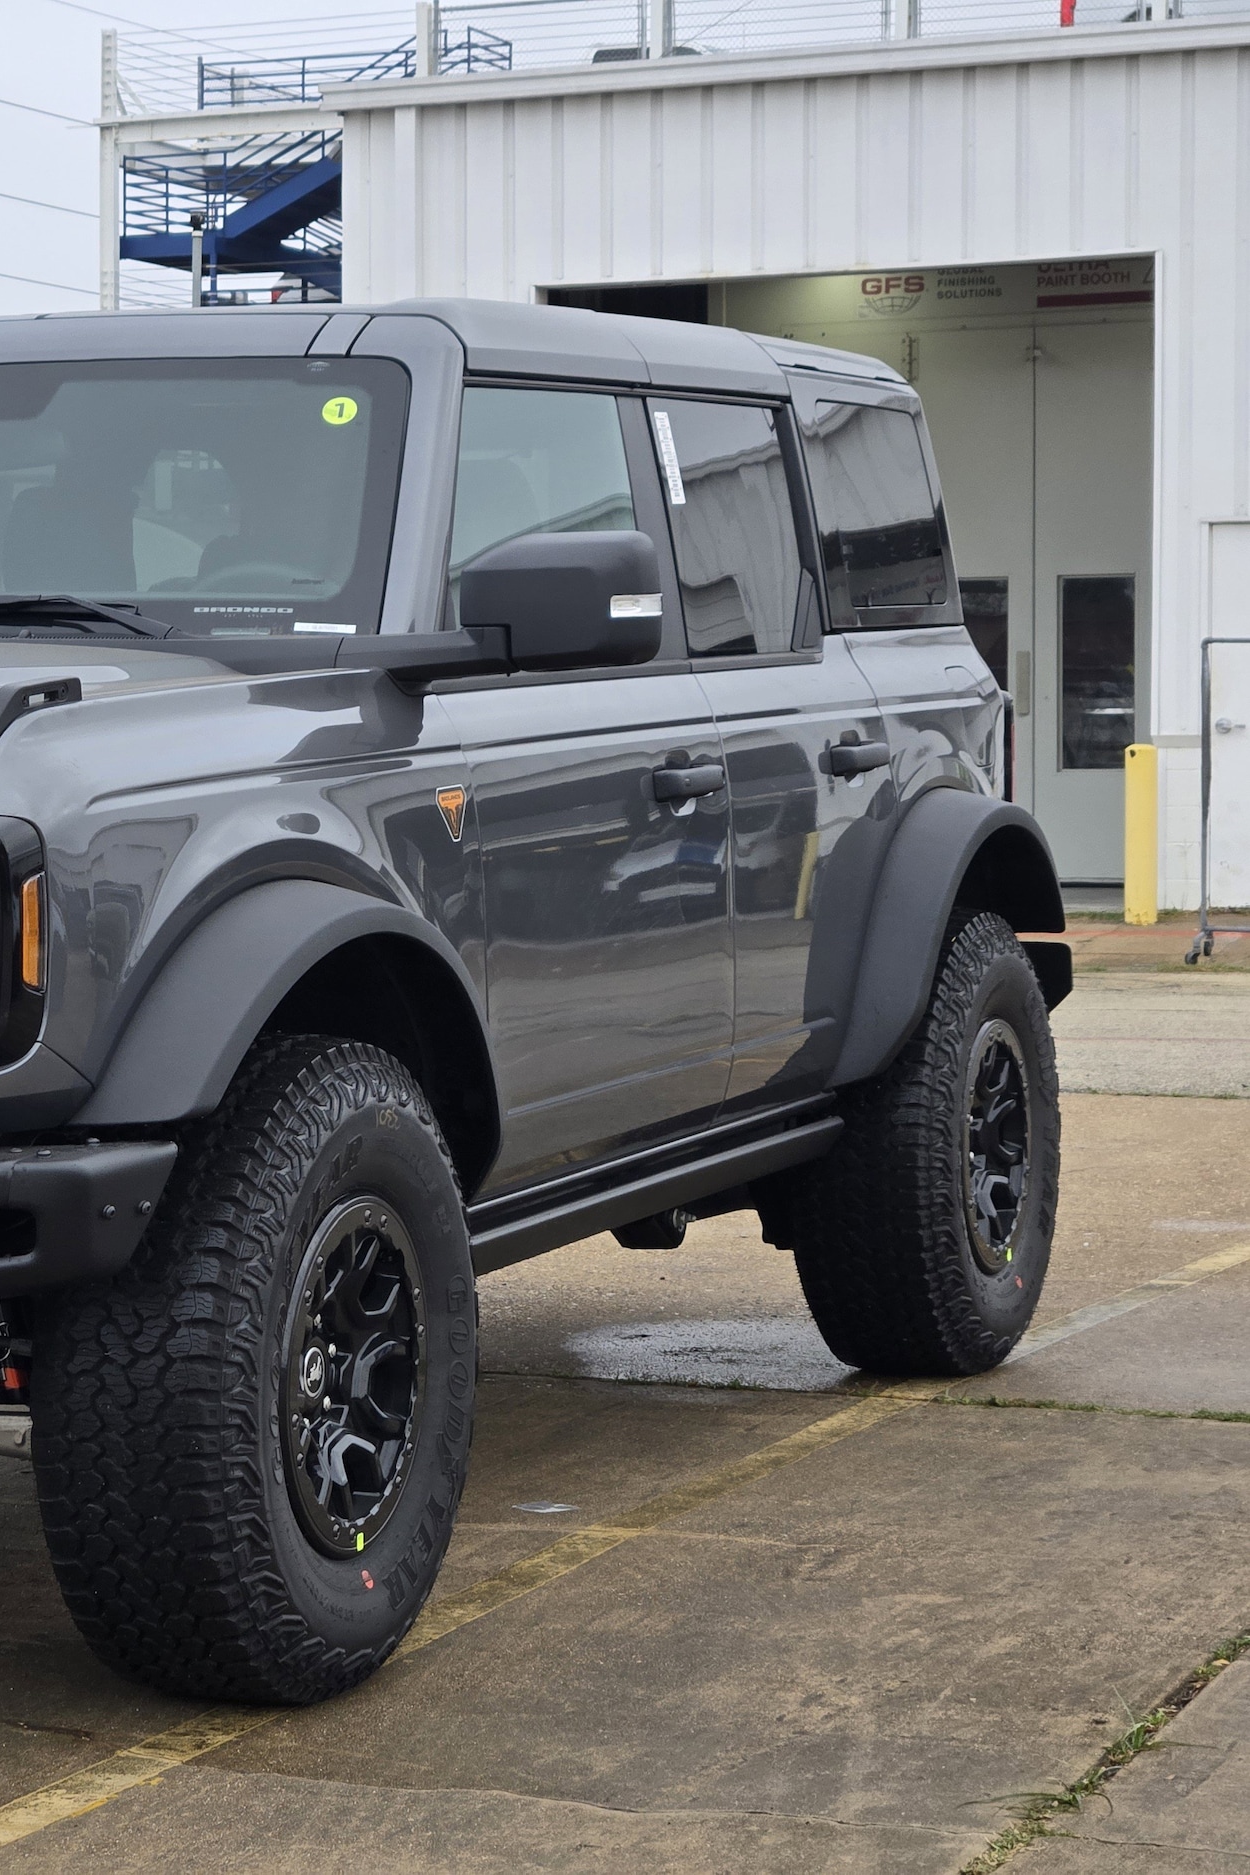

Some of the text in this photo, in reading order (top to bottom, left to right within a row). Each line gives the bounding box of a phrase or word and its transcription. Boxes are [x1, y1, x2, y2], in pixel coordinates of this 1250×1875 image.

[861, 275, 925, 295] GFS
[937, 275, 996, 288] FINISHING
[1037, 271, 1131, 288] PAINT BOOTH
[936, 287, 1003, 300] SOLUTIONS
